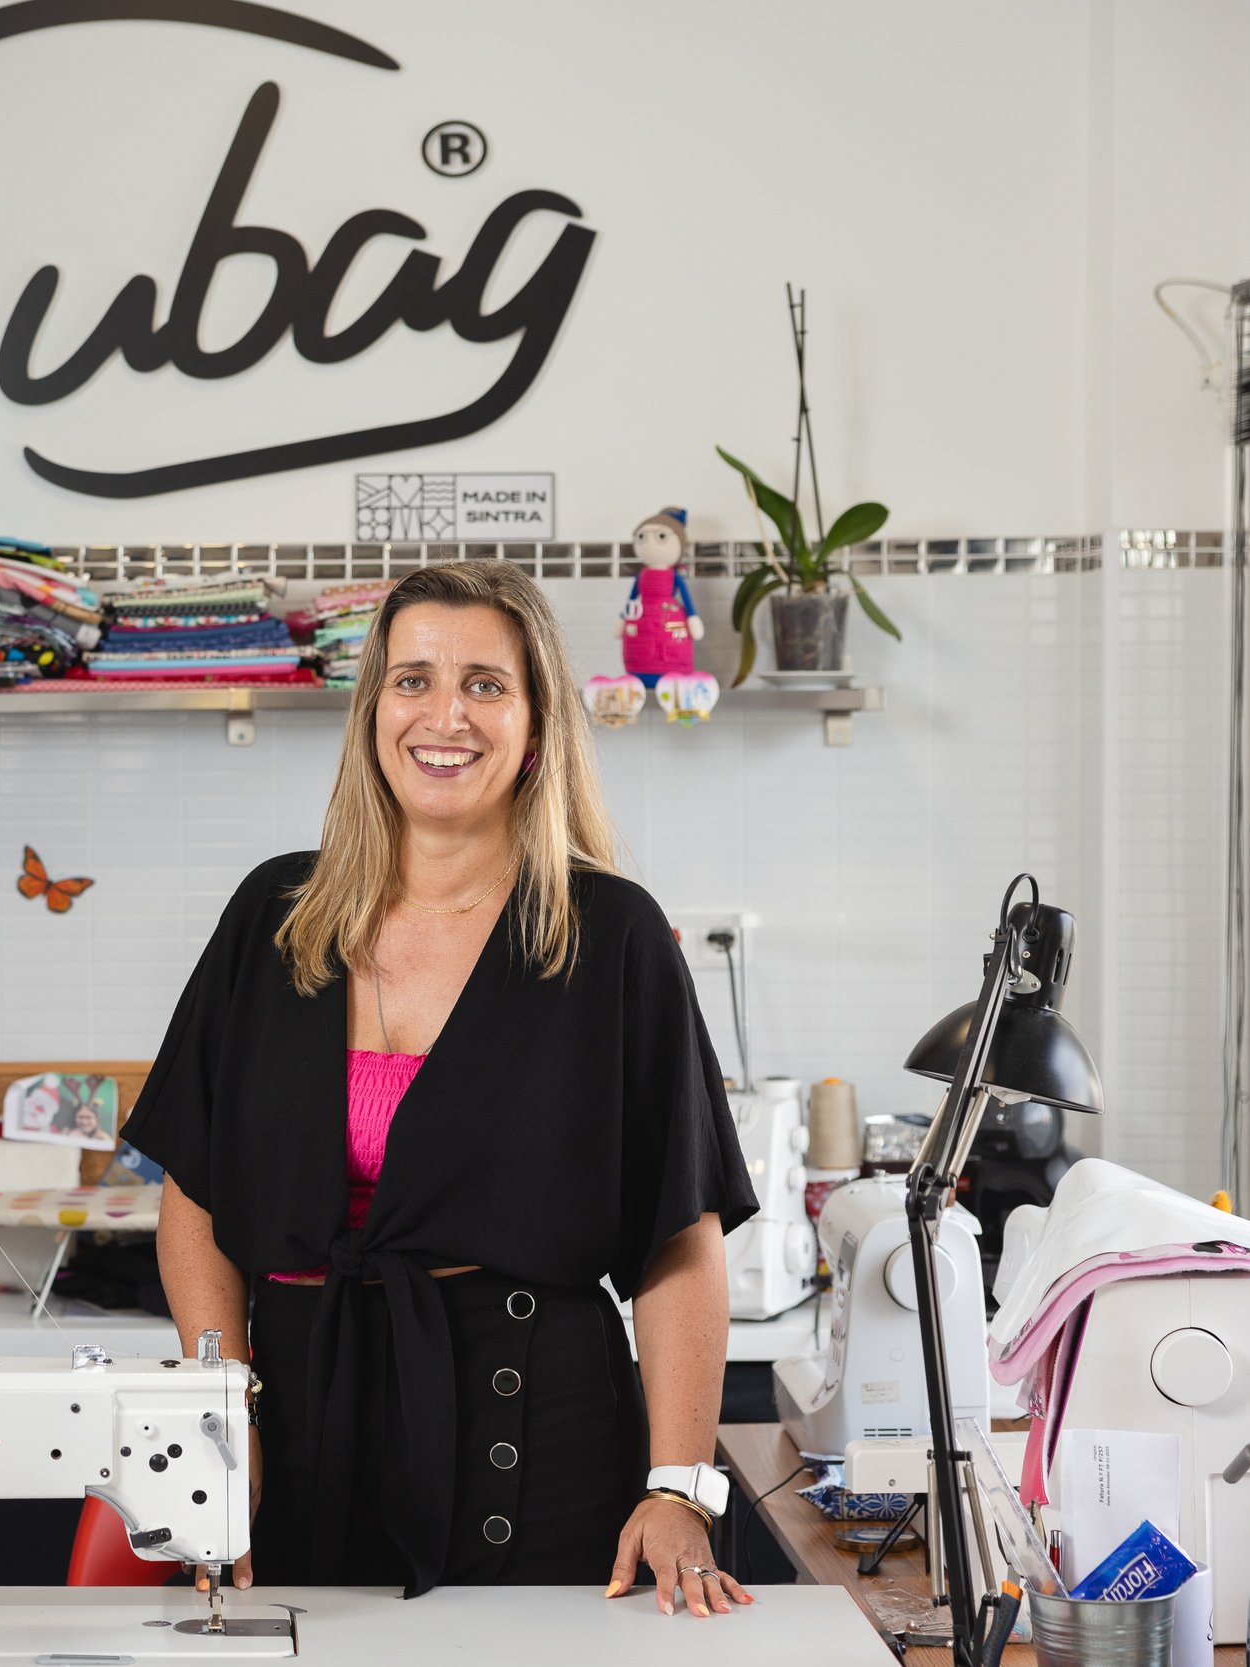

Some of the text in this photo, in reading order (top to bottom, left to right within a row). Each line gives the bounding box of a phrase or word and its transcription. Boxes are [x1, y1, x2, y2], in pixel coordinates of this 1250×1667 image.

[463, 491, 547, 503] MADE IN
[466, 510, 543, 523] SINTRA
